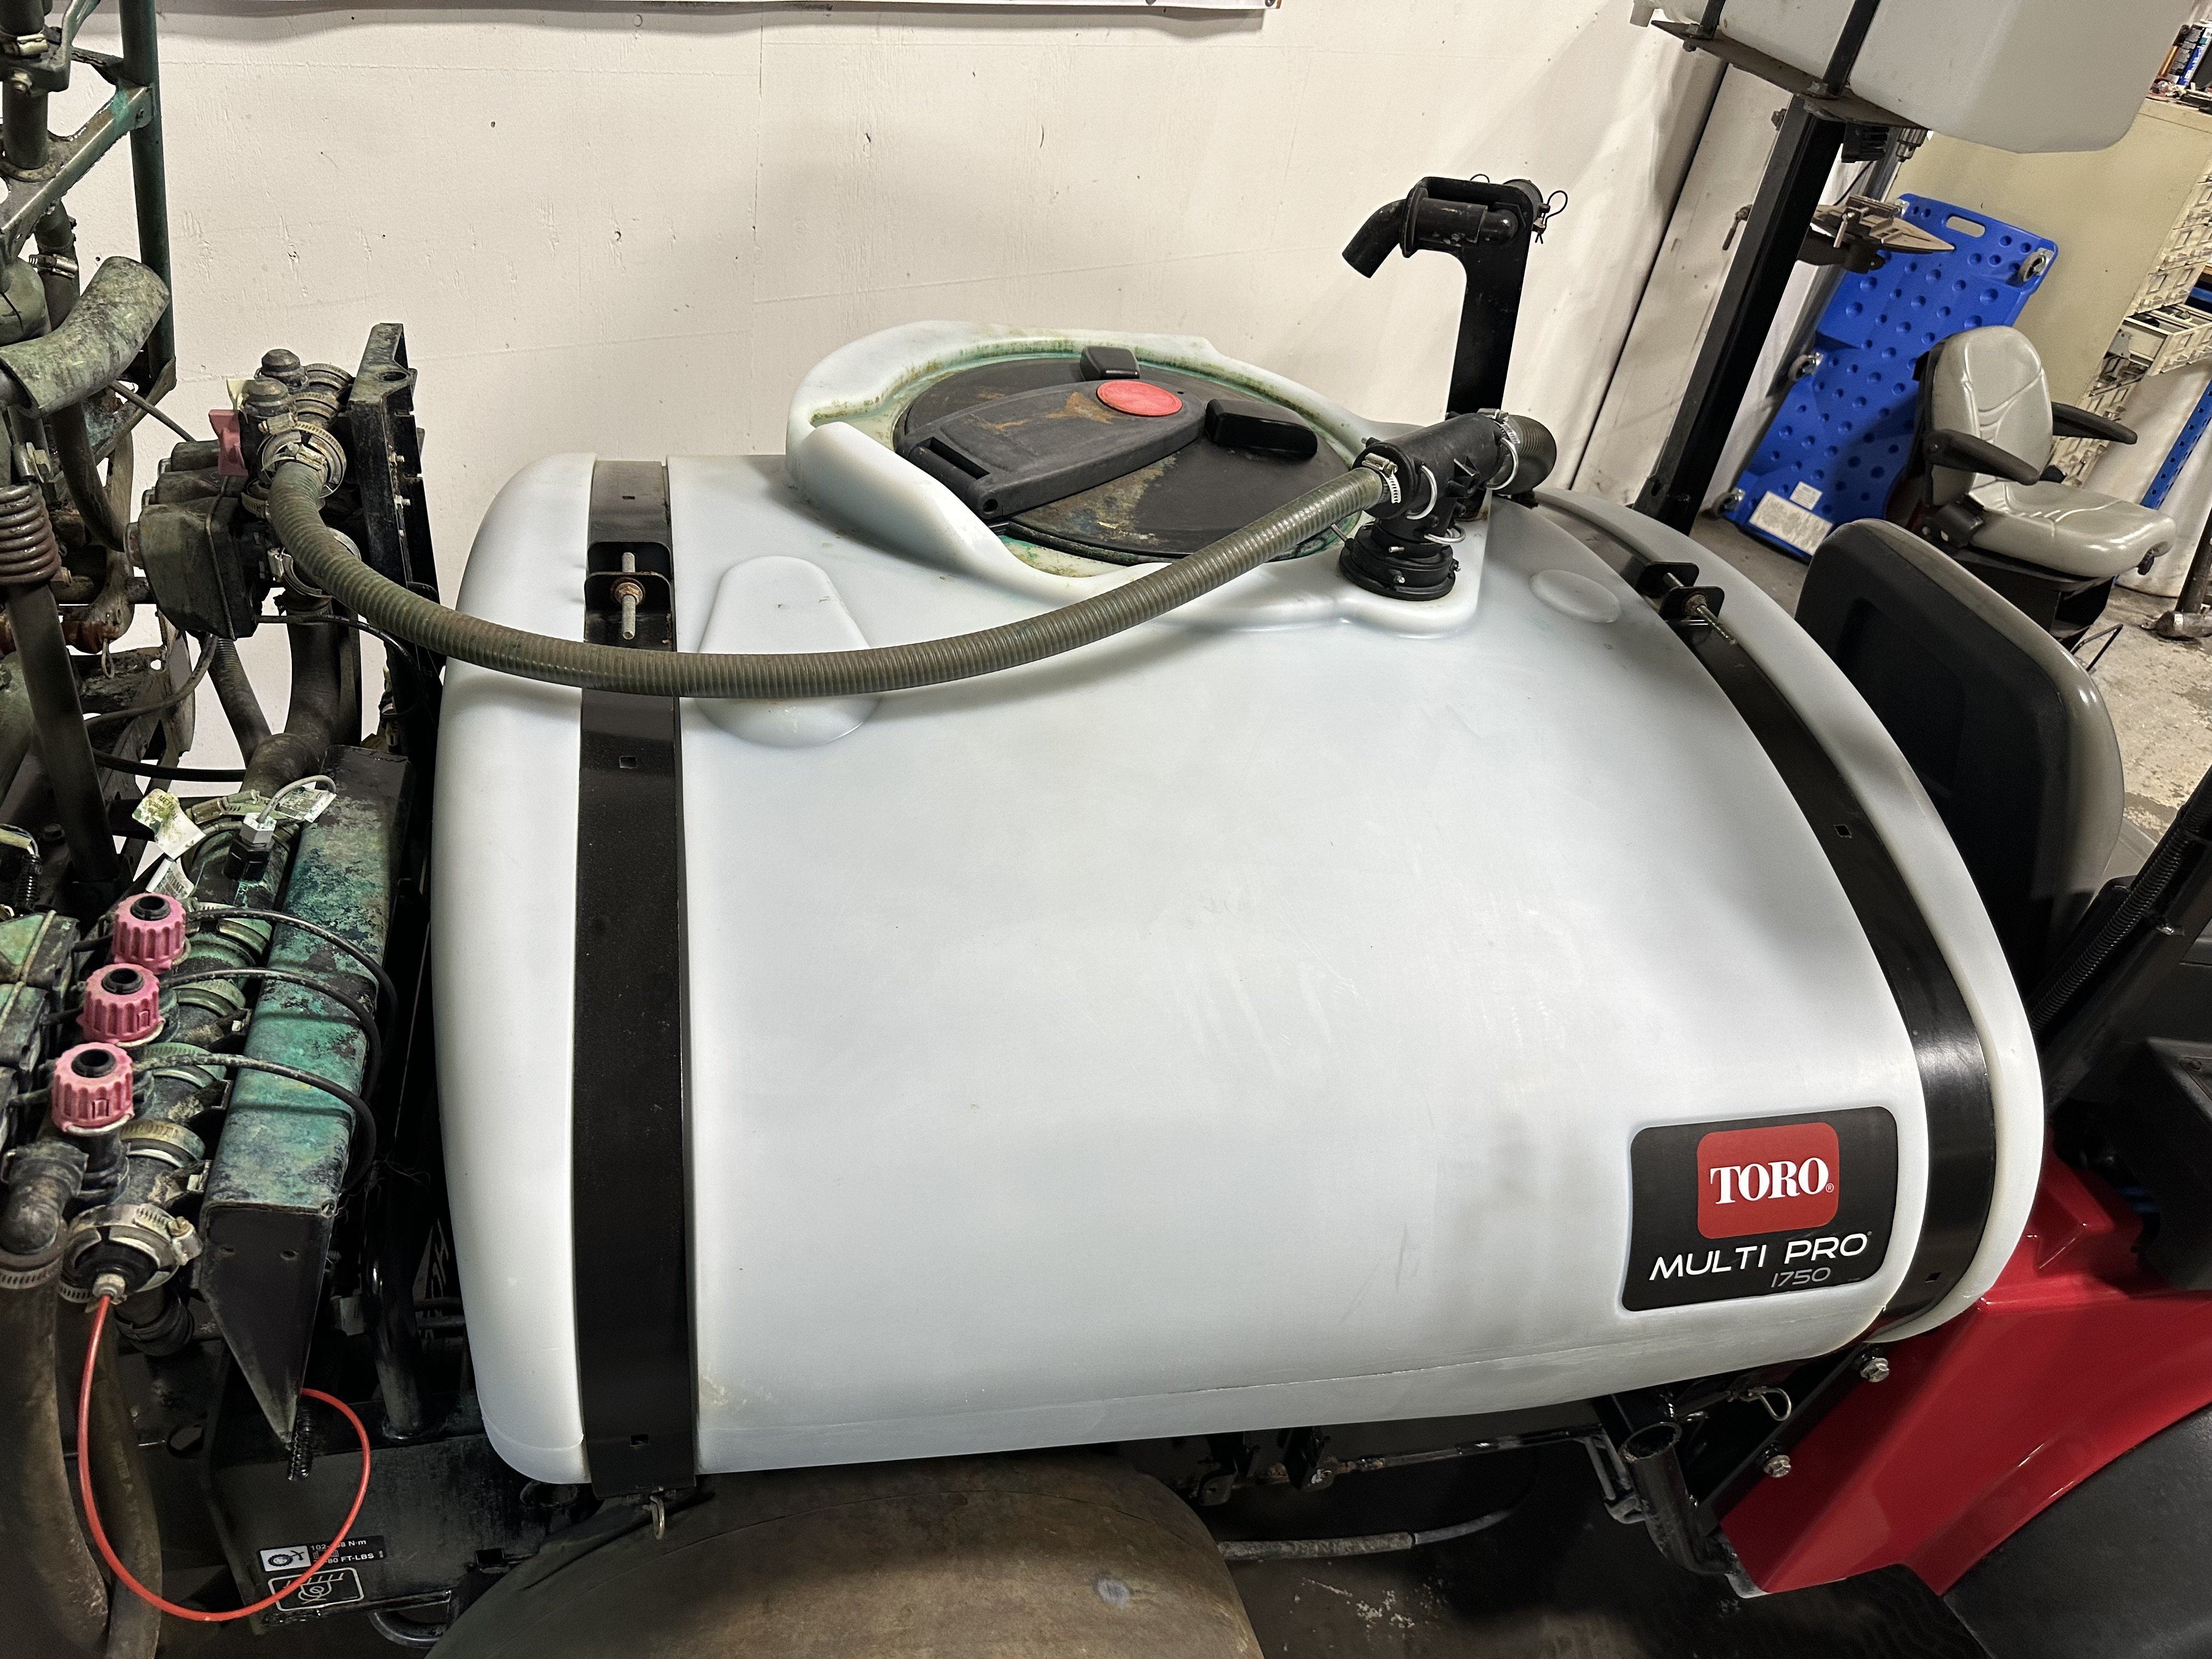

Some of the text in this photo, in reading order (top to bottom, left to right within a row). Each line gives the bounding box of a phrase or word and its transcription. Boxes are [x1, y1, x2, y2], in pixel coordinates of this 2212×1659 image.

[1709, 1157, 1829, 1205] TORO
[1649, 1232, 1867, 1280] MULTI PRO
[1770, 1267, 1831, 1288] 1750
[341, 1553, 374, 1562] FT-LBS
